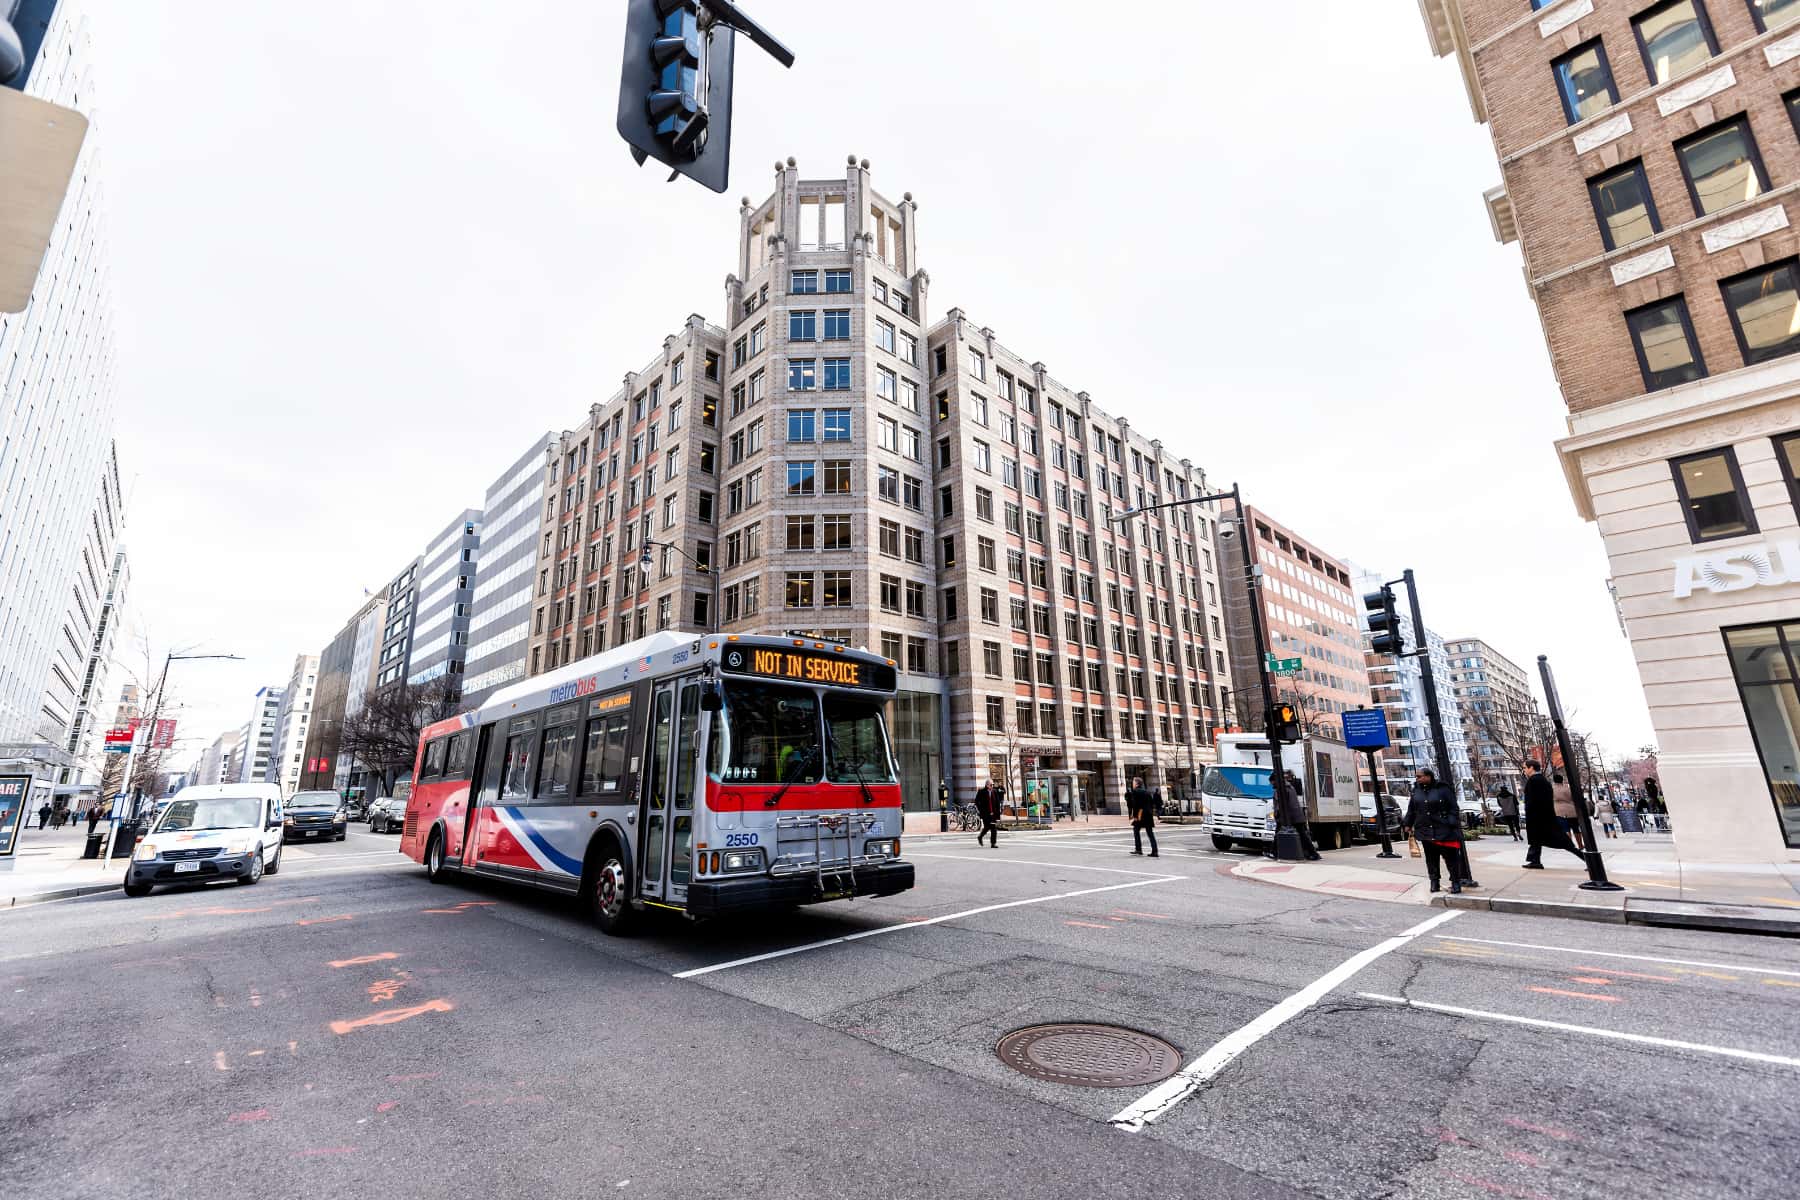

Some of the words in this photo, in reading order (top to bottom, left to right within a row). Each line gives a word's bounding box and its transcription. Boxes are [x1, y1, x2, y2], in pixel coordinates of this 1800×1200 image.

[1672, 541, 1800, 598] ASU
[672, 650, 689, 664] 2550
[755, 650, 782, 674] NOT
[786, 654, 802, 677] IN
[806, 658, 859, 684] SERVICE
[551, 676, 597, 703] metrobus
[726, 833, 758, 847] 2550
